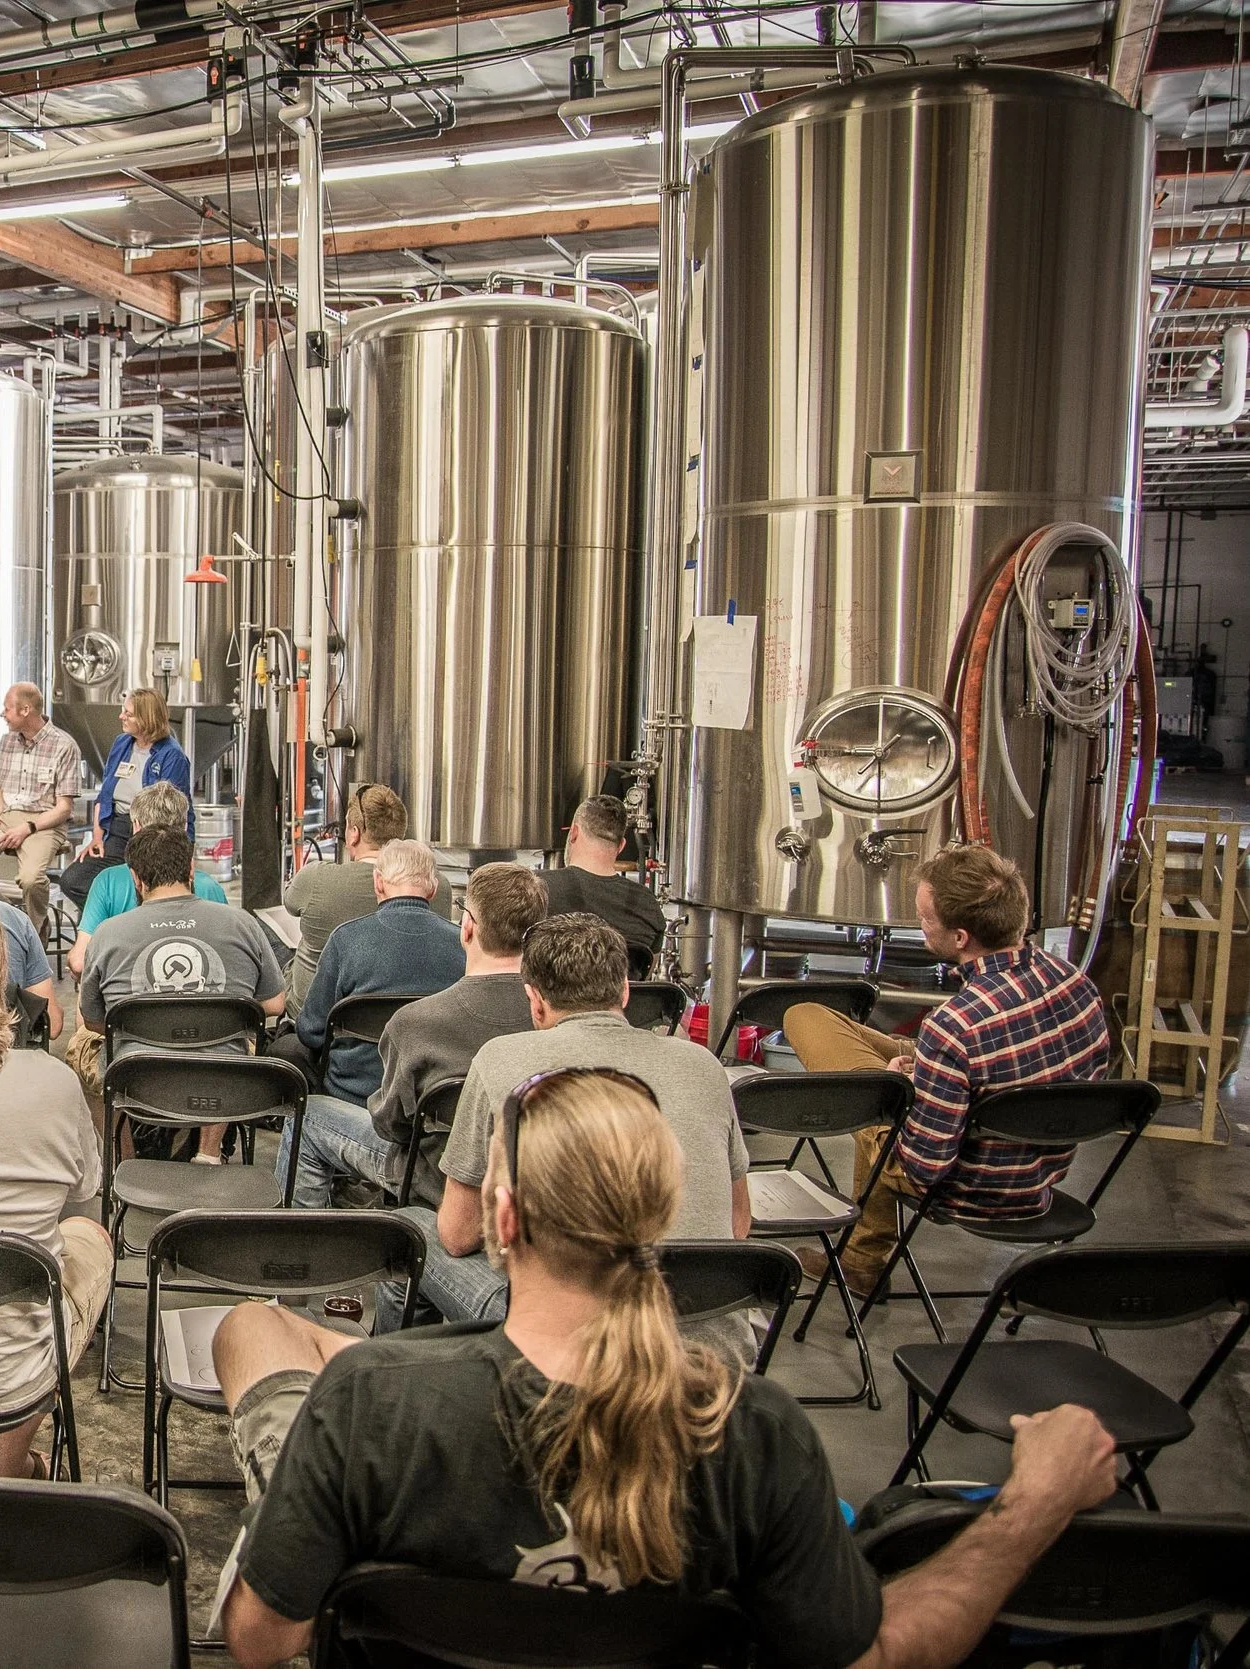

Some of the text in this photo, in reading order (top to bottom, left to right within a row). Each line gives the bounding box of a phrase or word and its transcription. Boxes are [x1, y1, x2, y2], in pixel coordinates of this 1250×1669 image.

[150, 919, 186, 929] HALO
[192, 1097, 217, 1108] PRE
[269, 1265, 301, 1279] PRE
